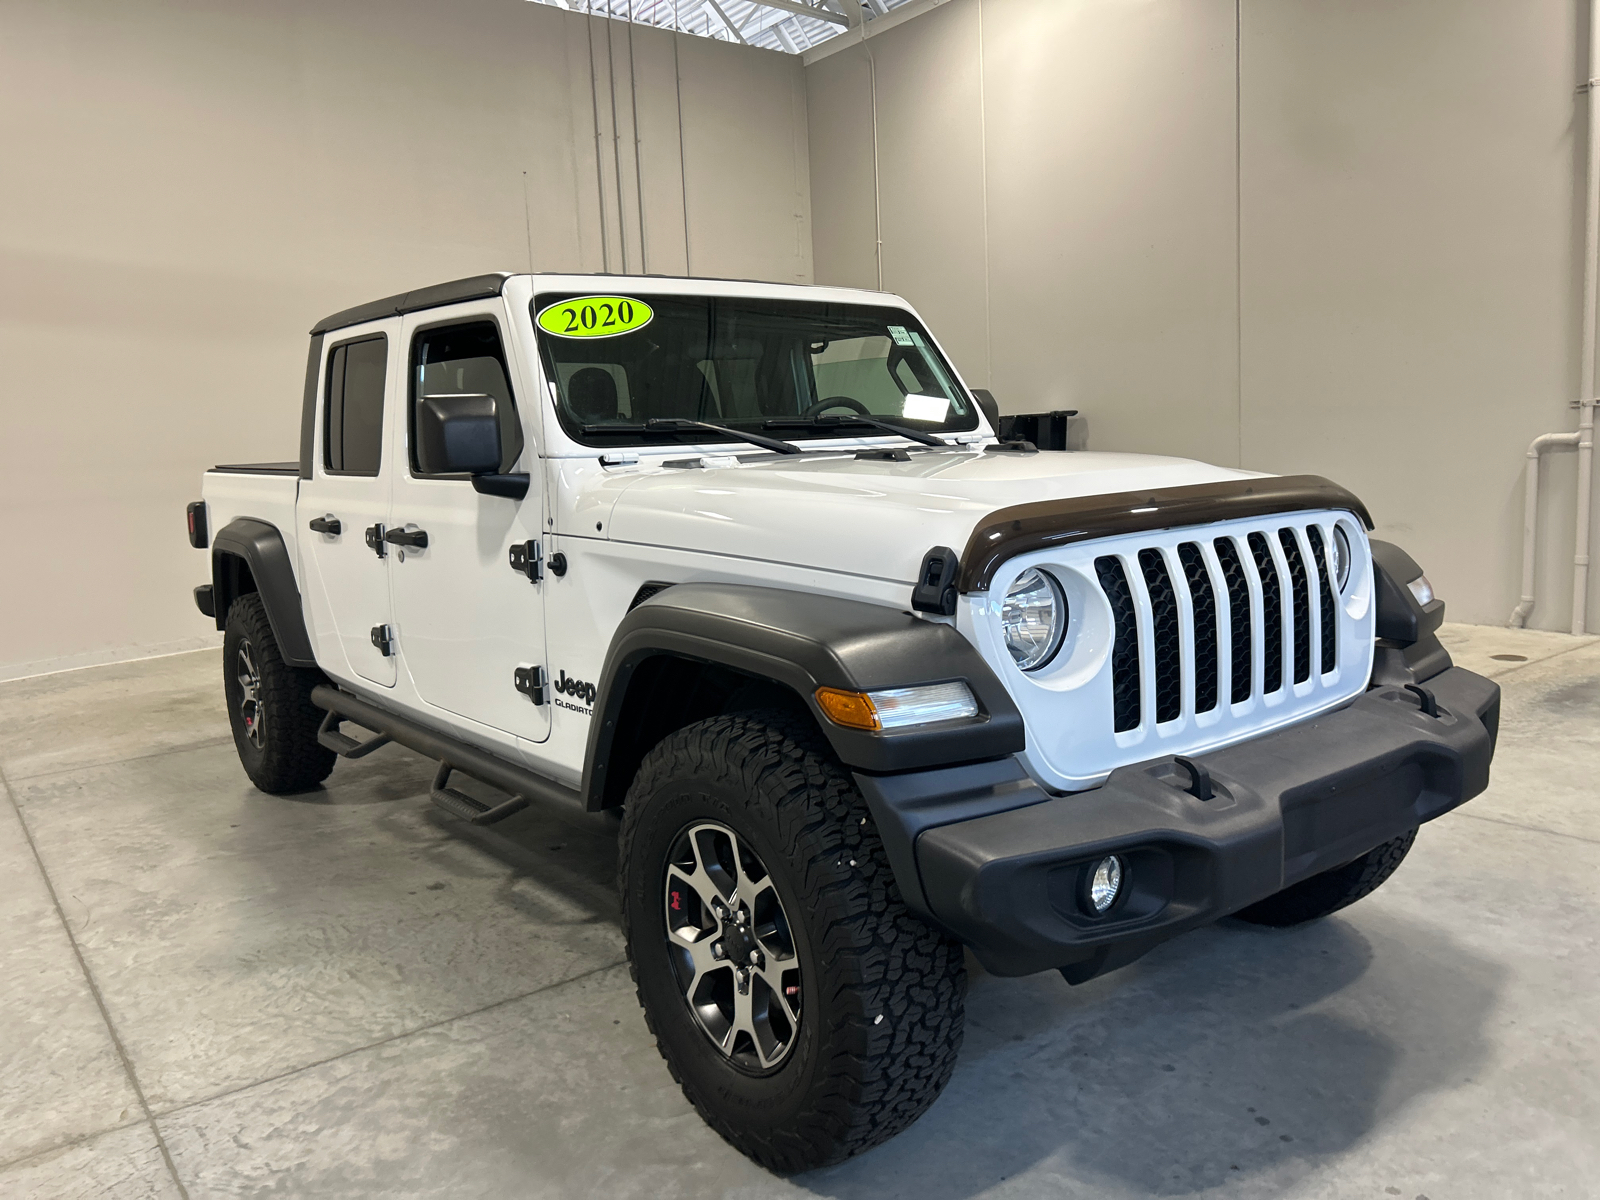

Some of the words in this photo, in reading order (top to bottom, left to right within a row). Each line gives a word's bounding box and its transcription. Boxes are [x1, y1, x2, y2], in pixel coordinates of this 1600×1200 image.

[562, 300, 634, 332] 2020
[554, 669, 597, 706] Jeep
[555, 698, 594, 717] GLADIATO
